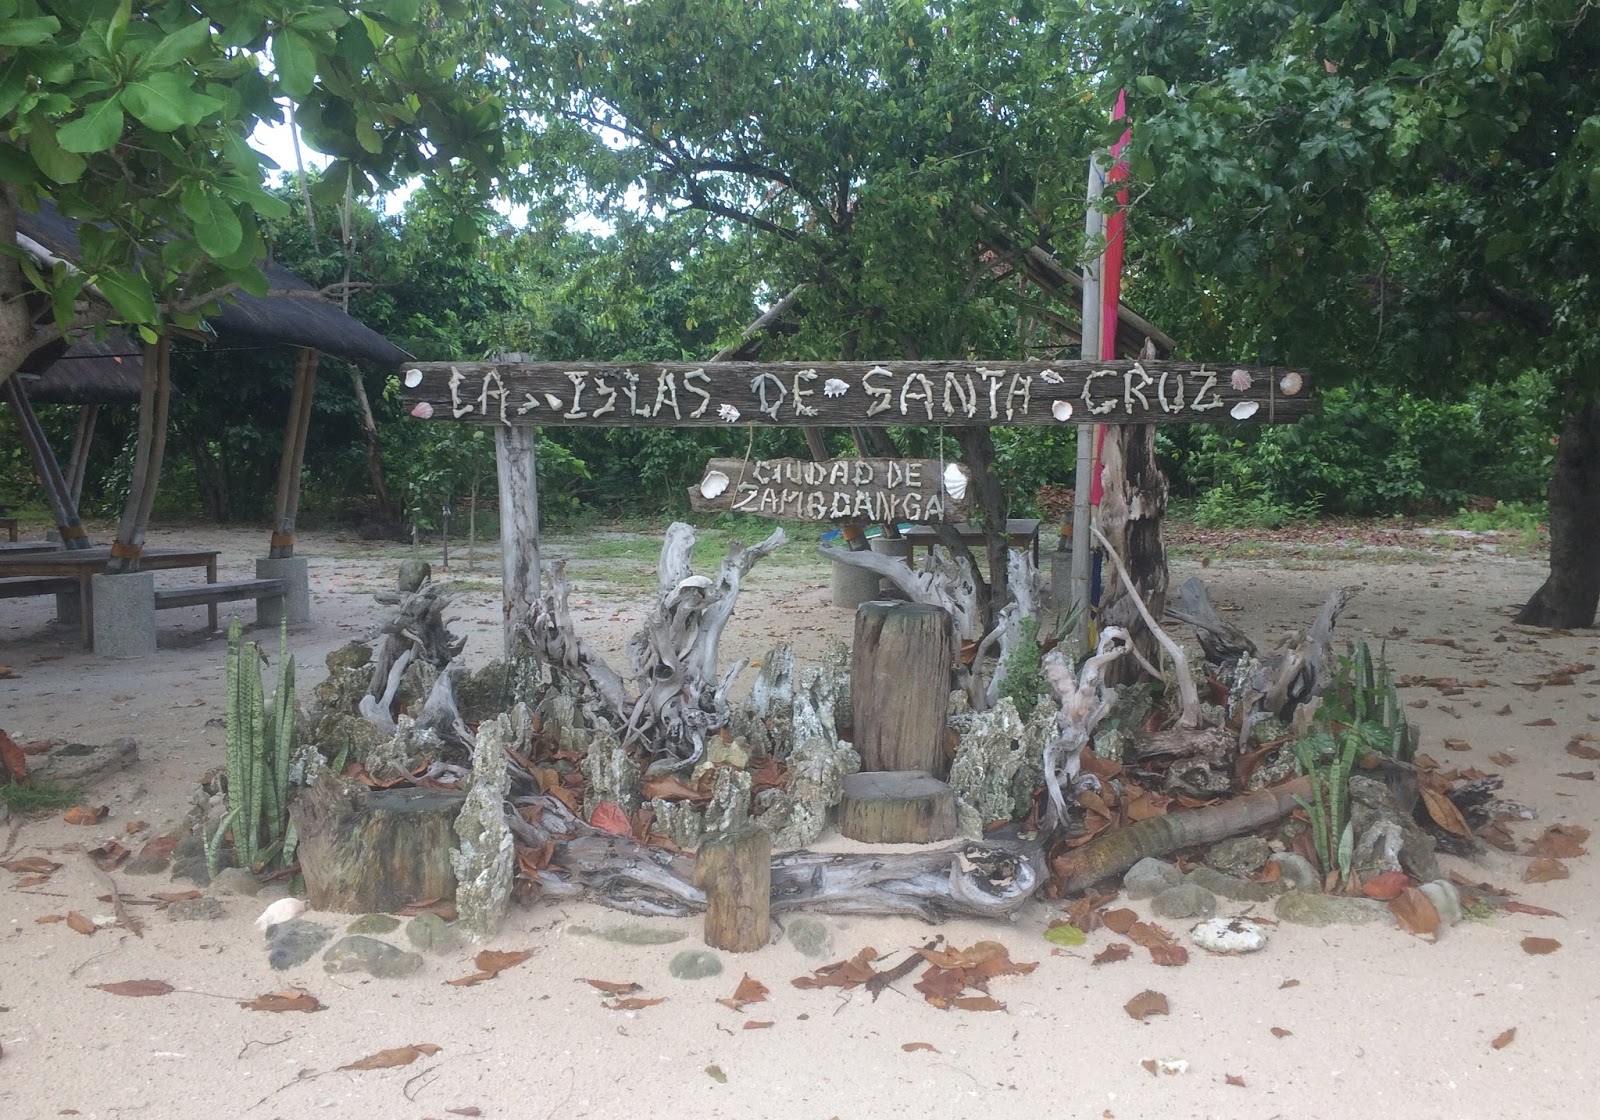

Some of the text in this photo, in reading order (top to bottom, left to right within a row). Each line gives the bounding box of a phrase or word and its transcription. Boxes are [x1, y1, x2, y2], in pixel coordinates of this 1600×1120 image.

[563, 368, 712, 421] ISLAS
[750, 367, 819, 421] DE
[861, 365, 1033, 422] SANTA
[1080, 362, 1225, 414] CRUZ
[752, 460, 922, 489] CIUDAD DE
